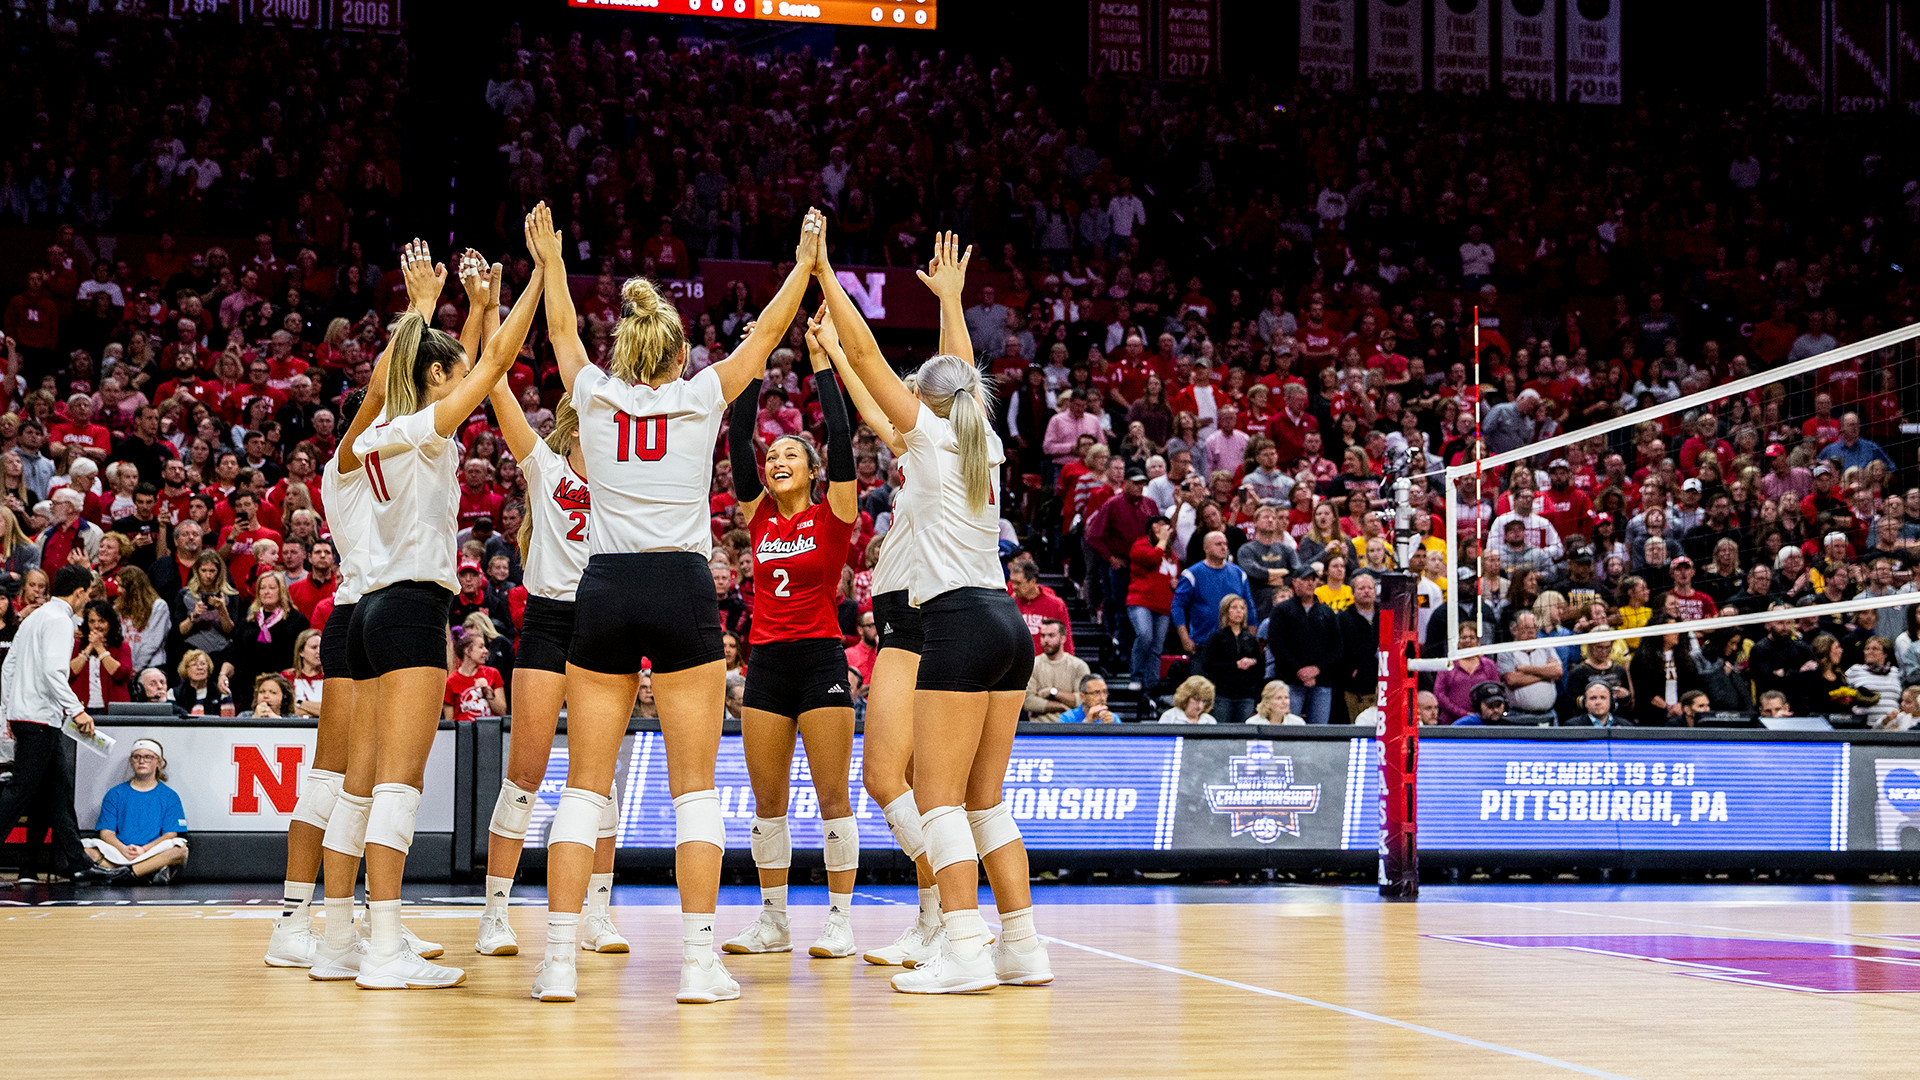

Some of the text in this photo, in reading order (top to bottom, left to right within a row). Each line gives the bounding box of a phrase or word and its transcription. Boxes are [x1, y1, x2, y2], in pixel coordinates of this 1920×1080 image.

[341, 1, 389, 26] 2006
[1100, 3, 1139, 17] NCAA
[1168, 7, 1209, 21] NCAA
[1099, 49, 1142, 72] 2015
[1168, 52, 1210, 76] 2017
[1571, 79, 1618, 97] 2018
[613, 409, 668, 462] 10
[364, 450, 391, 503] 11
[553, 477, 590, 505] Nebr
[566, 511, 590, 542] 2
[756, 532, 816, 556] Nebraska
[773, 568, 790, 597] 2
[229, 743, 306, 816] N
[1376, 651, 1391, 885] NEBRASKA
[1505, 761, 1695, 786] DECEMBER 19 & 21
[1003, 788, 1137, 820] IONSHIP
[1216, 790, 1312, 806] CHAMPIONSHIP
[1480, 790, 1729, 826] PITTSBURGH, PA
